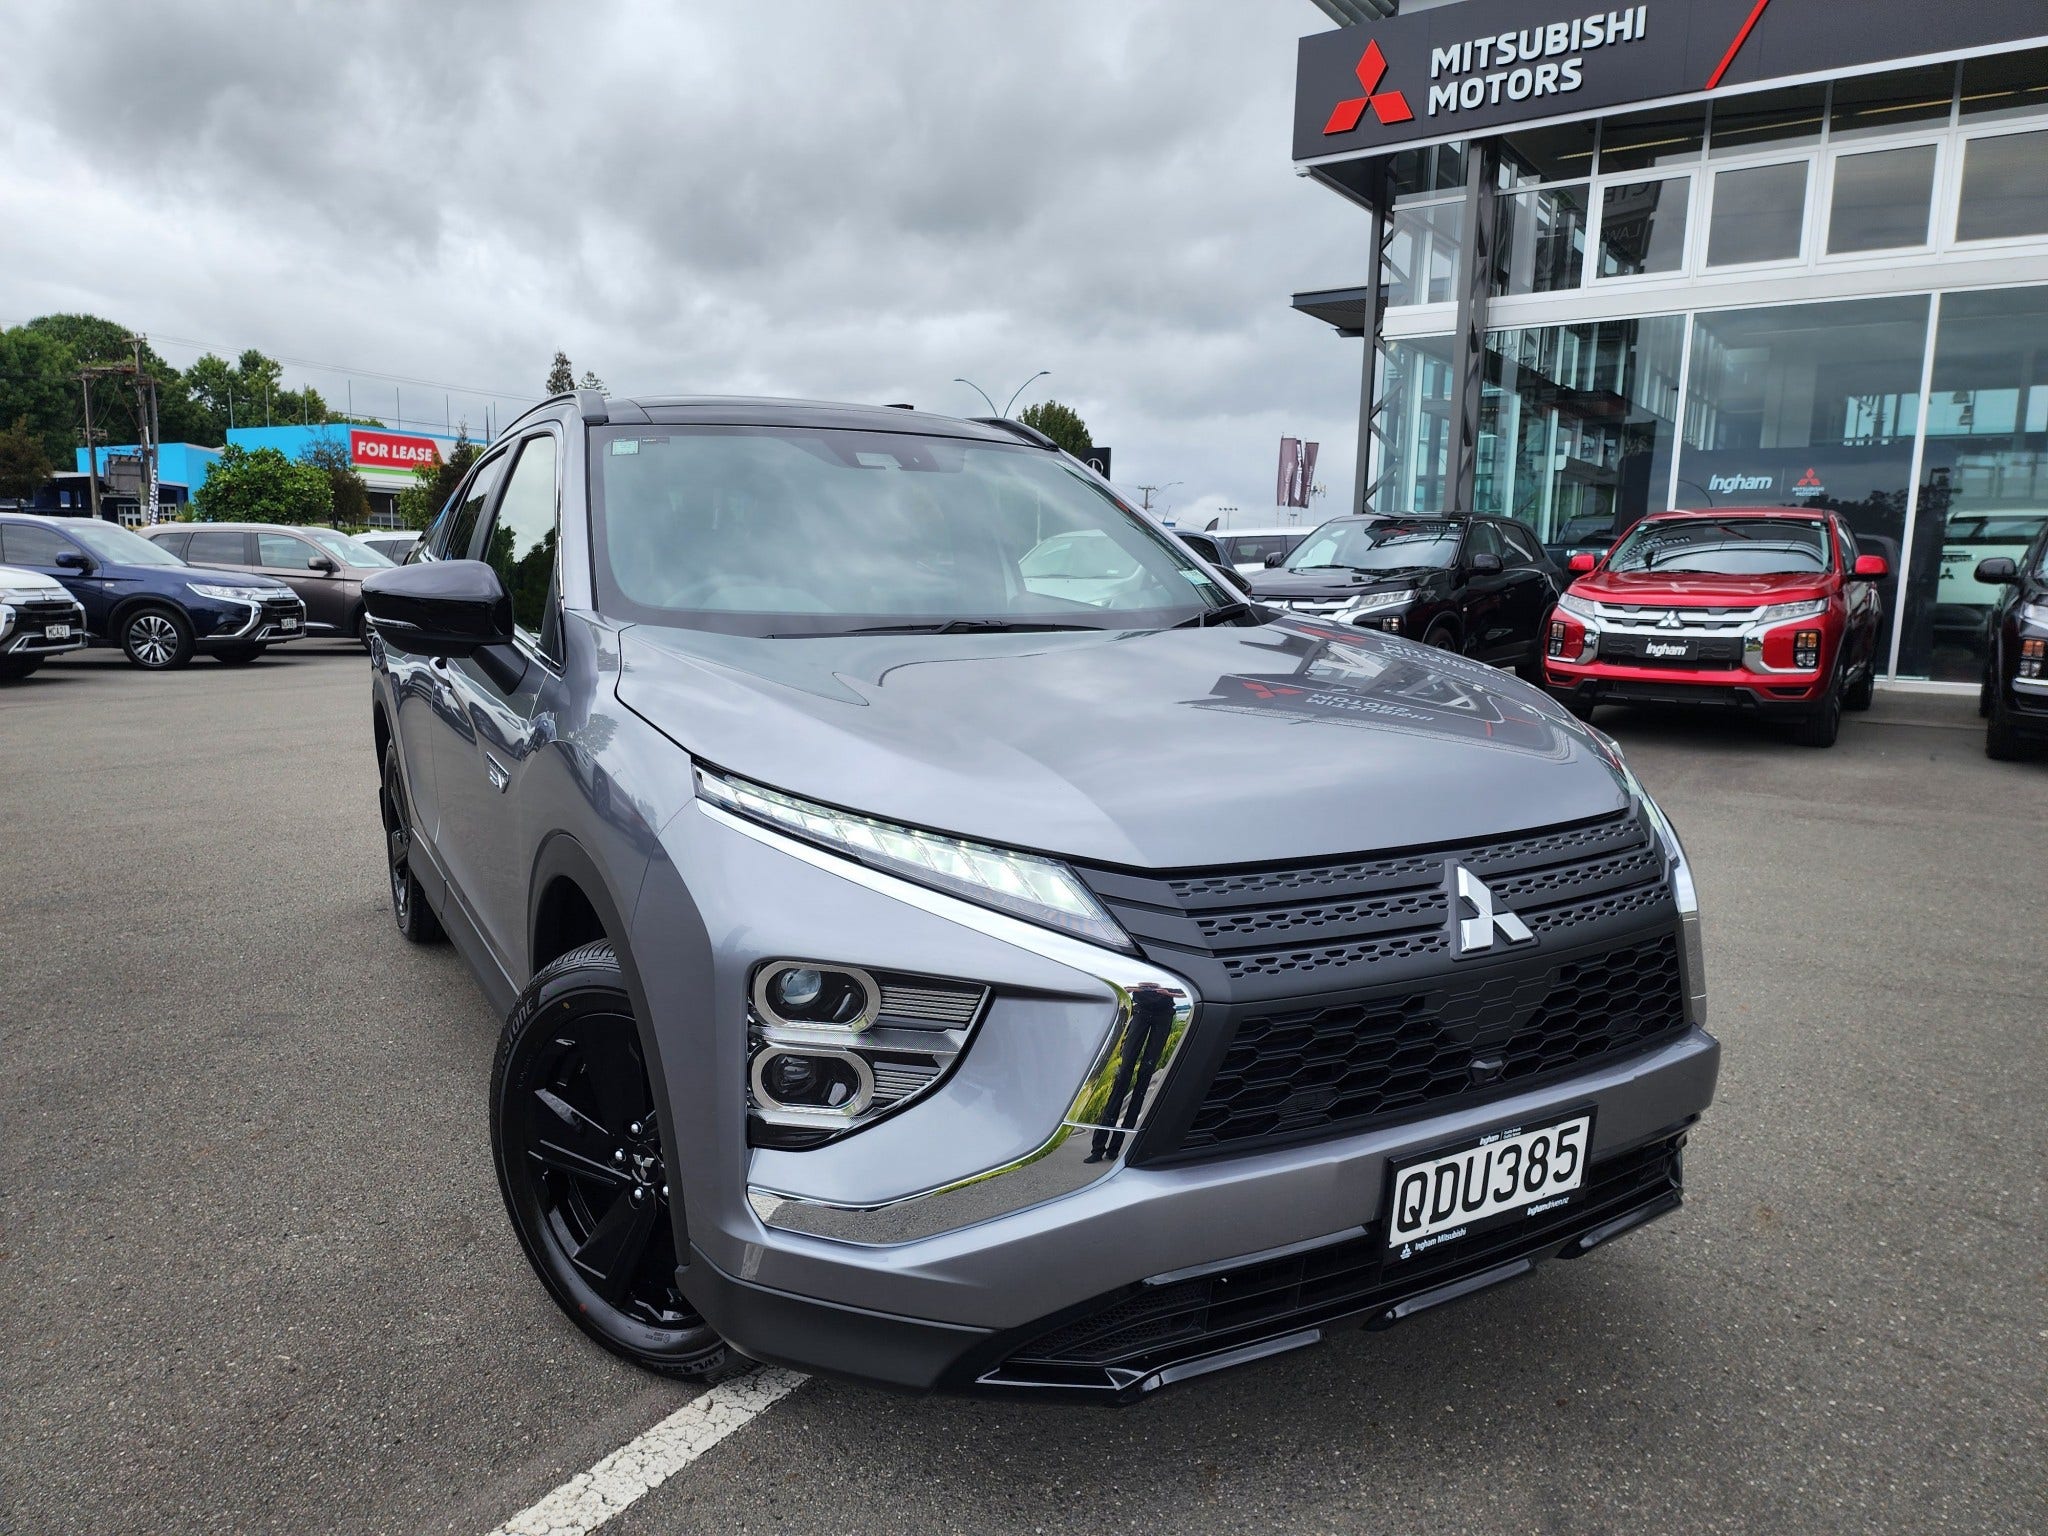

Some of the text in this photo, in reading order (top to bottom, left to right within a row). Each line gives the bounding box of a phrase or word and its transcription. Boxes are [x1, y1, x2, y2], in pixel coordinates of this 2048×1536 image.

[1430, 5, 1648, 78] MITSUBISHI
[1428, 57, 1583, 116] MOTORS
[358, 441, 432, 461] FOR LEASE
[1708, 473, 1773, 494] Ingham
[1646, 642, 1687, 657] Ingham
[1397, 1125, 1580, 1233] QDU385
[1415, 1227, 1467, 1251] Ingham Mitsubishi
